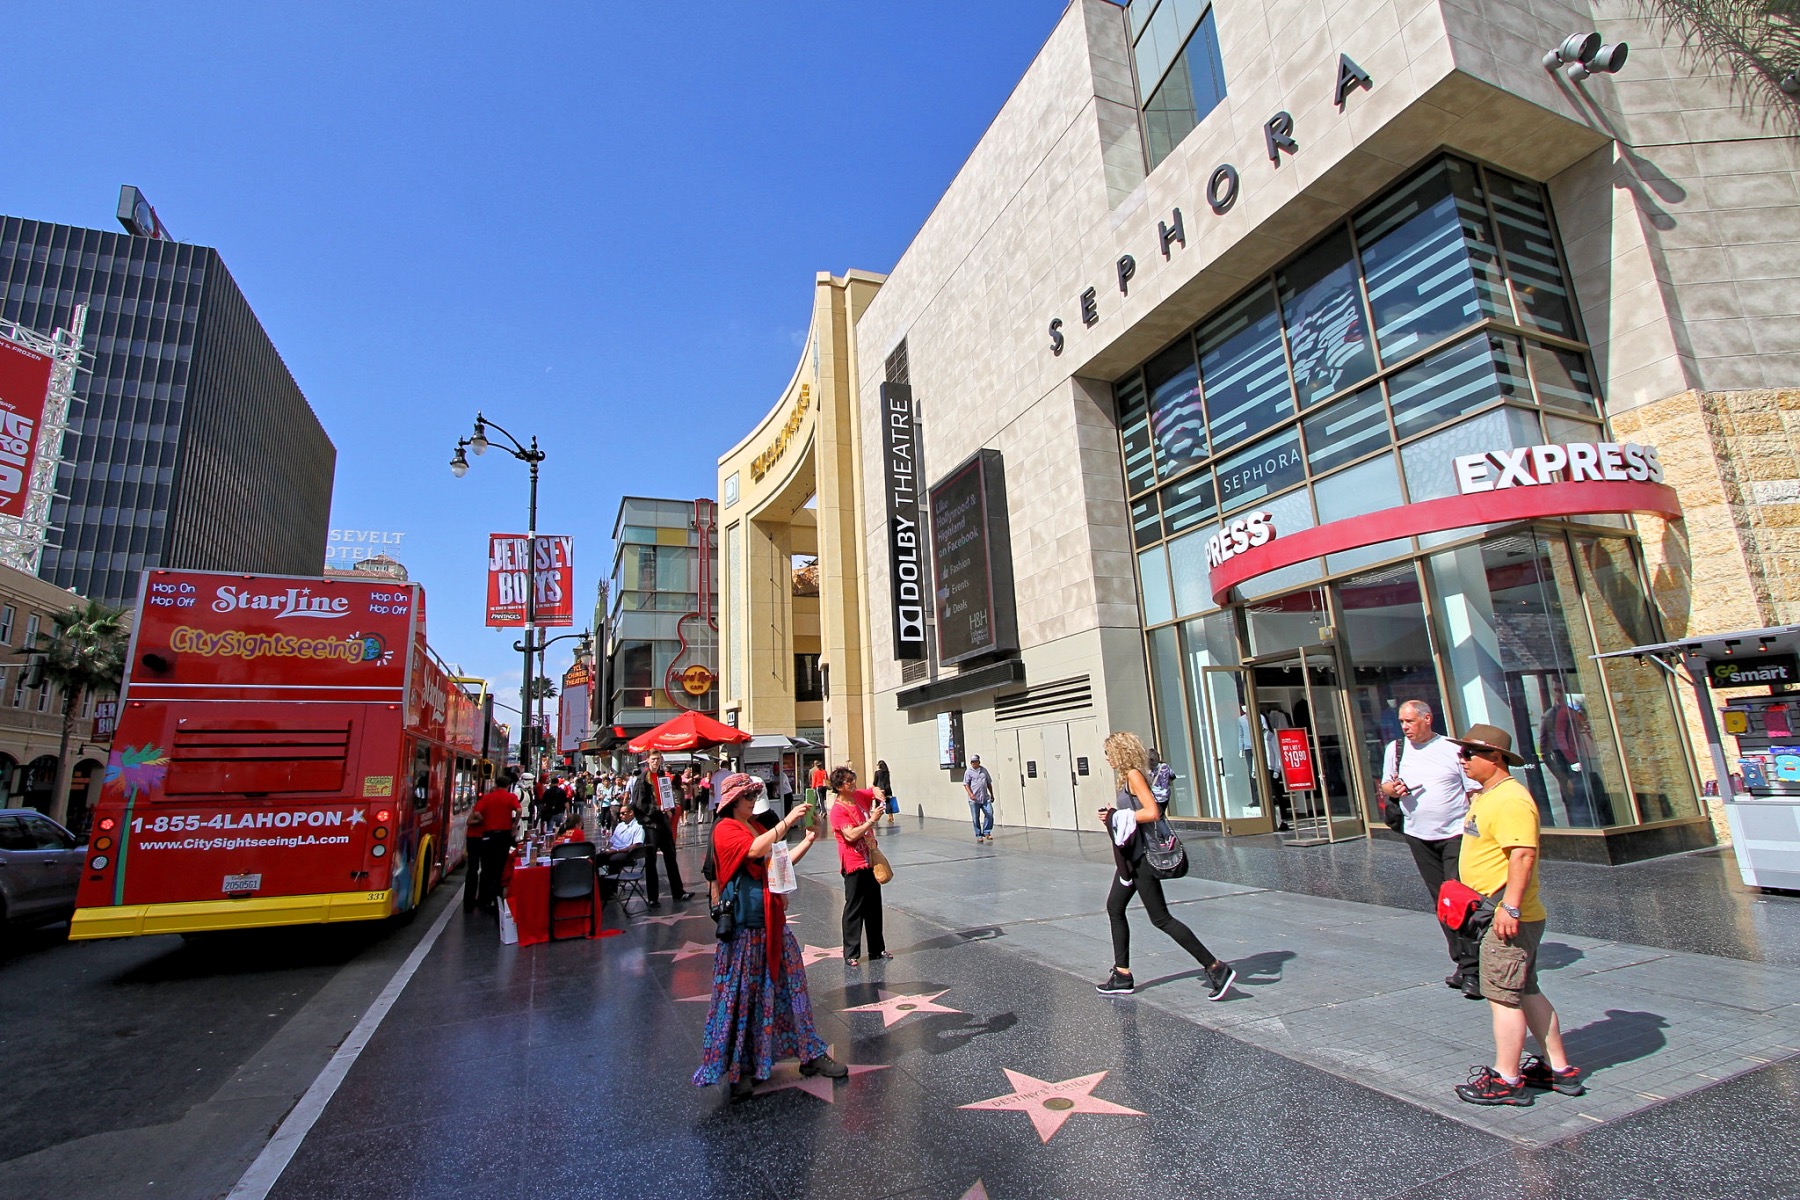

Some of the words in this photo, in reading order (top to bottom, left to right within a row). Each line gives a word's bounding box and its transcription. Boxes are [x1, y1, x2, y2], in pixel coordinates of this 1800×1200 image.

[1049, 52, 1373, 357] SEPHORA
[12, 345, 42, 361] FROZEN
[889, 397, 914, 508] THEATRE
[1223, 448, 1301, 493] SEPHORA
[1453, 442, 1665, 495] EXPRESS
[936, 496, 970, 528] Hollywood
[330, 529, 406, 544] SEVELT
[948, 525, 979, 553] Facebook
[1204, 511, 1277, 572] PRESS
[490, 536, 573, 571] JERSEY
[896, 514, 920, 601] DOLBY
[950, 557, 971, 576] Fashion
[153, 583, 176, 594] Hop
[180, 583, 196, 593] On
[371, 592, 391, 602] Hop
[394, 592, 408, 602] On
[498, 570, 563, 605] BOYS
[951, 581, 970, 595] Events
[151, 596, 173, 606] Hop
[177, 597, 196, 607] Off
[212, 586, 352, 619] StarLine
[369, 604, 389, 614] Hop
[392, 605, 408, 615] Off
[952, 599, 968, 614] Deals
[1714, 664, 1738, 678] Go
[1729, 665, 1788, 682] smart
[131, 811, 342, 833] 1-855-4LAHOPON
[139, 834, 349, 850] www.CitySightseeingLA.com
[367, 892, 385, 901] 331
[991, 1086, 1051, 1107] DESTINY'S
[1054, 1079, 1091, 1093] CHILD
